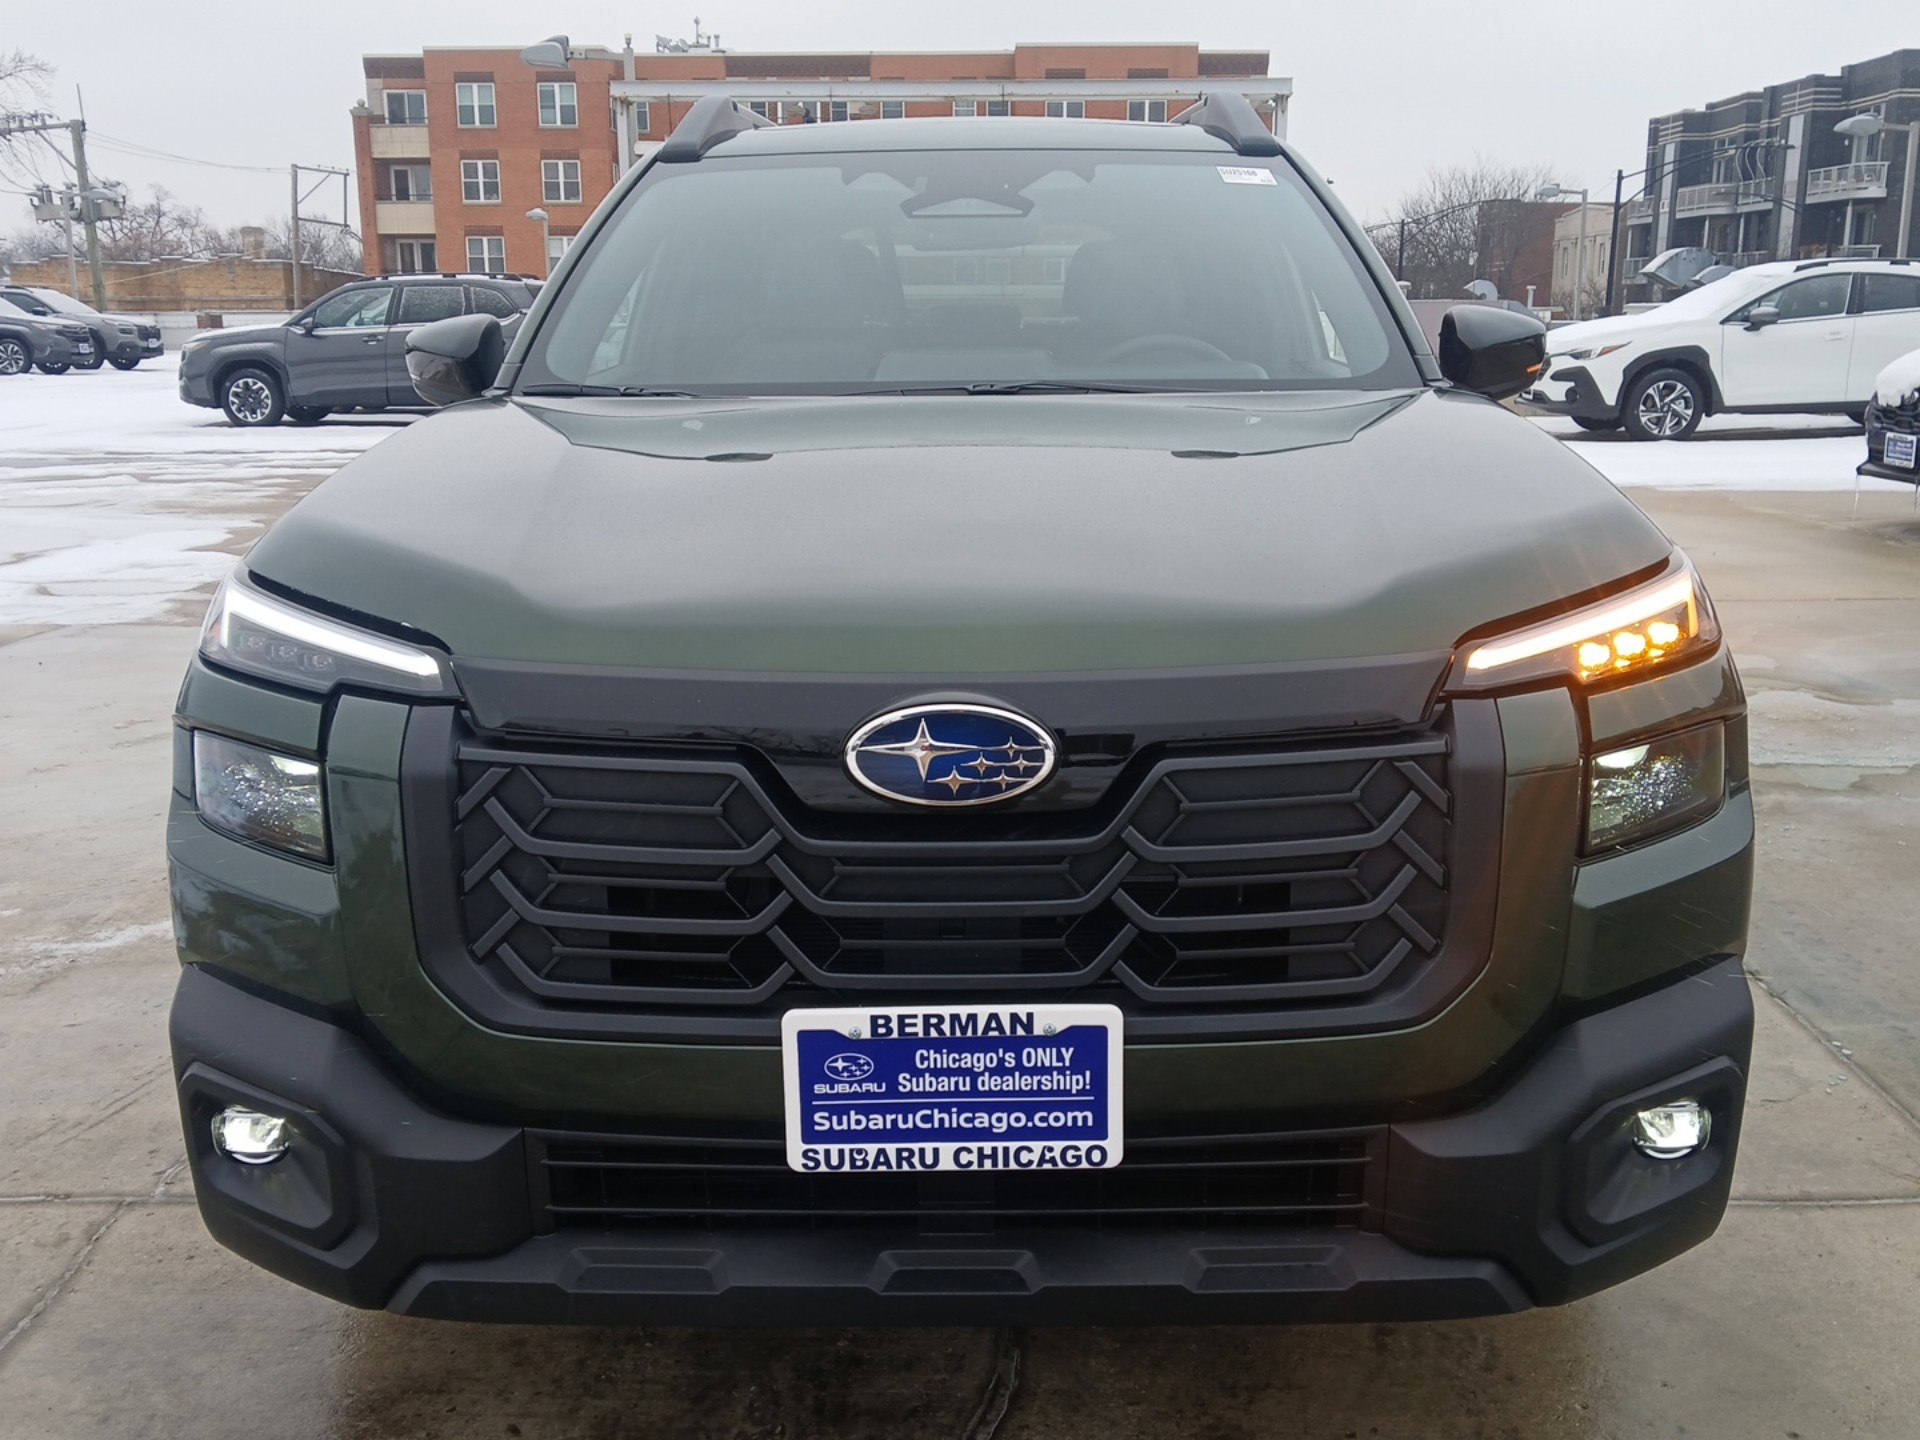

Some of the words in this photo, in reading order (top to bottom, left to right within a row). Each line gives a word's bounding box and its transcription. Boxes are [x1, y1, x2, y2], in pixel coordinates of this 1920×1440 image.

[869, 1012, 1034, 1038] BERMAN
[915, 1049, 1015, 1072] Chicago's
[1022, 1047, 1075, 1068] ONLY
[813, 1082, 886, 1094] SUBARU
[898, 1072, 971, 1092] Subaru
[977, 1070, 1091, 1093] dealership!
[813, 1108, 1094, 1133] SubaruChicago.com
[801, 1147, 940, 1171] SUBARU
[952, 1144, 1108, 1170] CHICAGO
